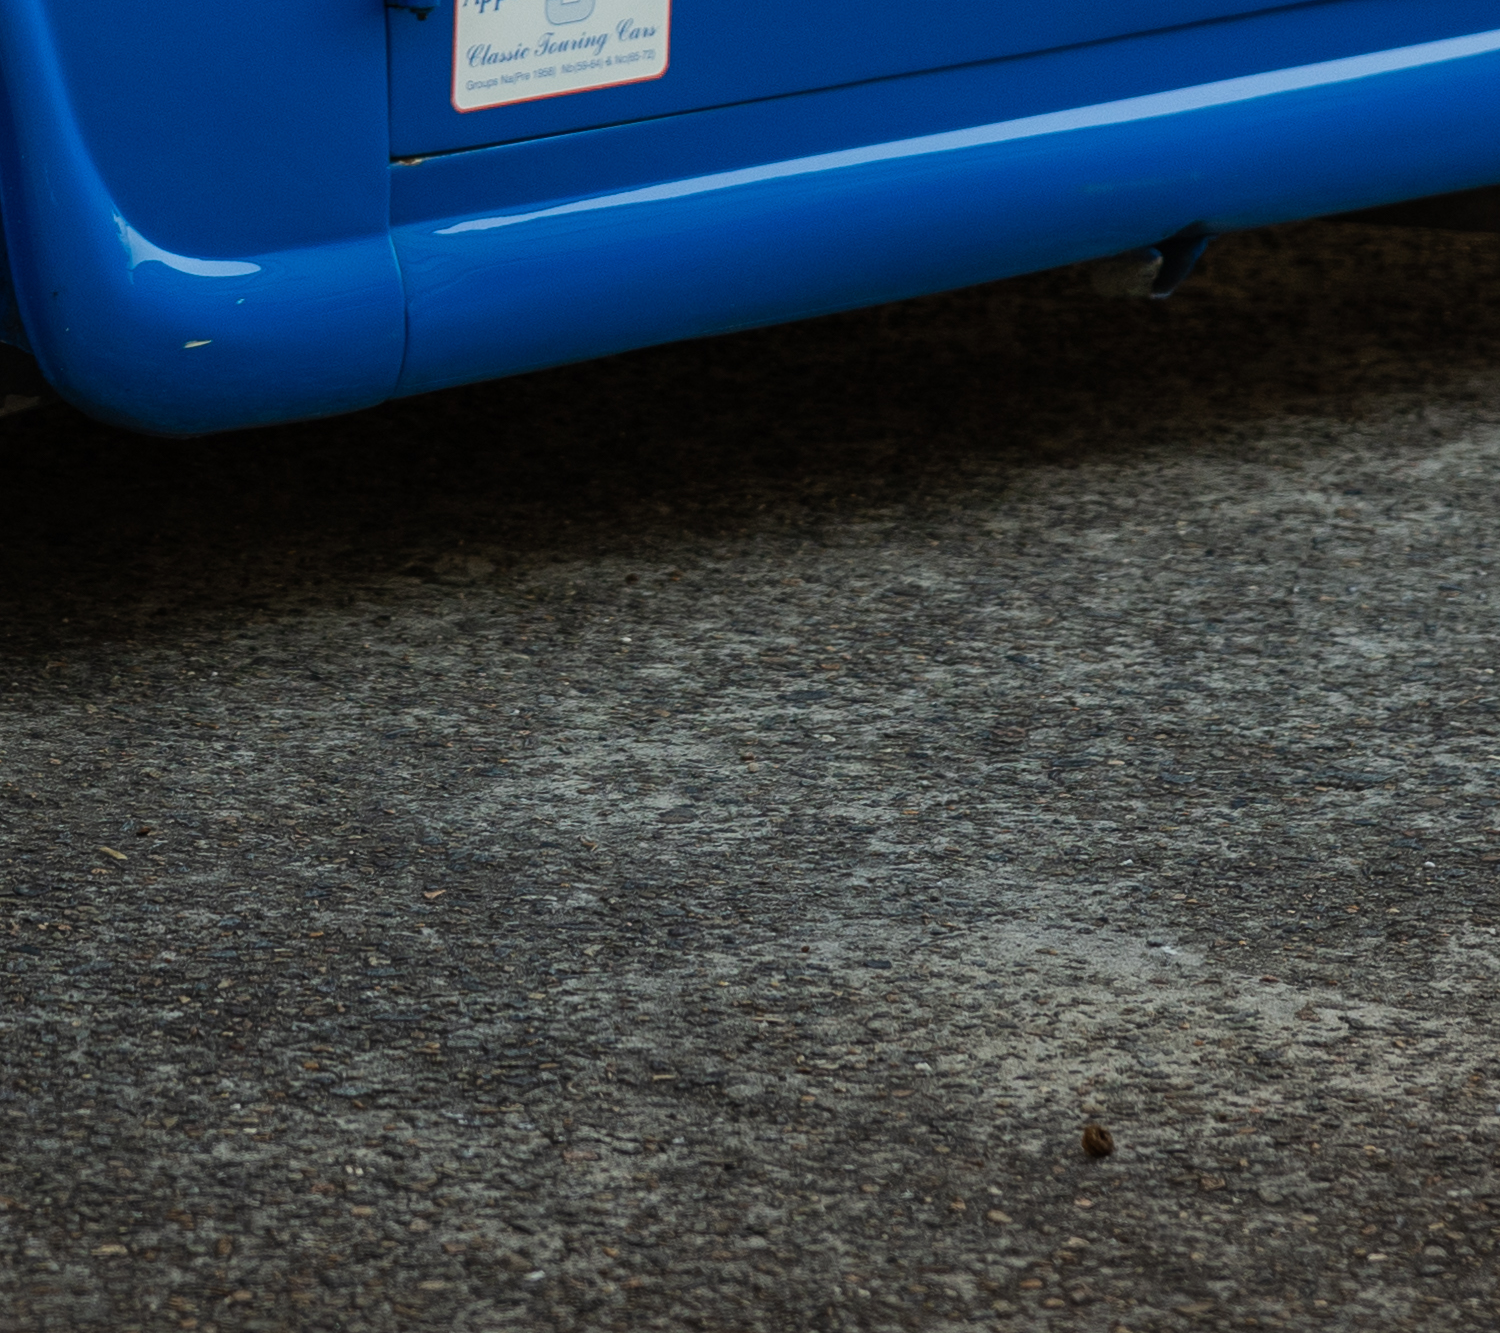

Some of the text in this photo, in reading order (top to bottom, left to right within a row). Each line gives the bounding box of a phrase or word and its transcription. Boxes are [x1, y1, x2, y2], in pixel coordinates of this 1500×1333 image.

[466, 17, 658, 68] Classic Touring Cars
